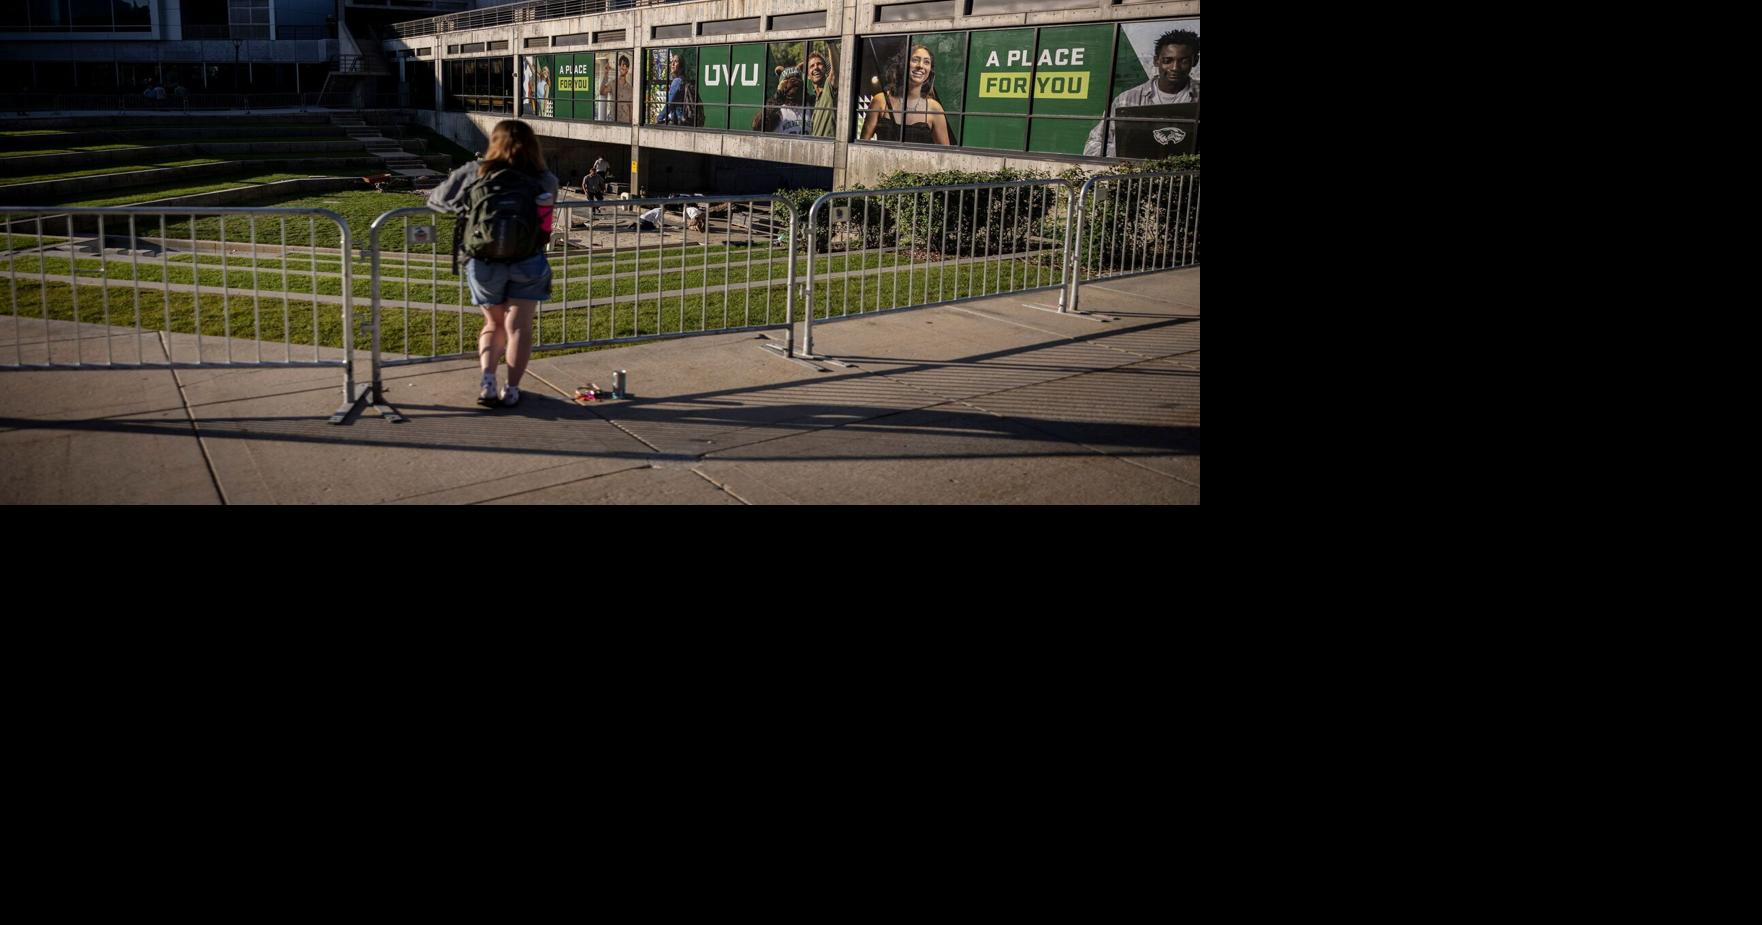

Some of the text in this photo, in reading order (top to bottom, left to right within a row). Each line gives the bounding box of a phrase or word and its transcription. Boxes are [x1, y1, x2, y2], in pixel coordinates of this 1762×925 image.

[985, 47, 1085, 67] A PLACE
[559, 65, 587, 74] A PLACE
[704, 63, 759, 87] UVU
[560, 79, 587, 88] FOR YOU
[986, 77, 1082, 94] FOR YOU
